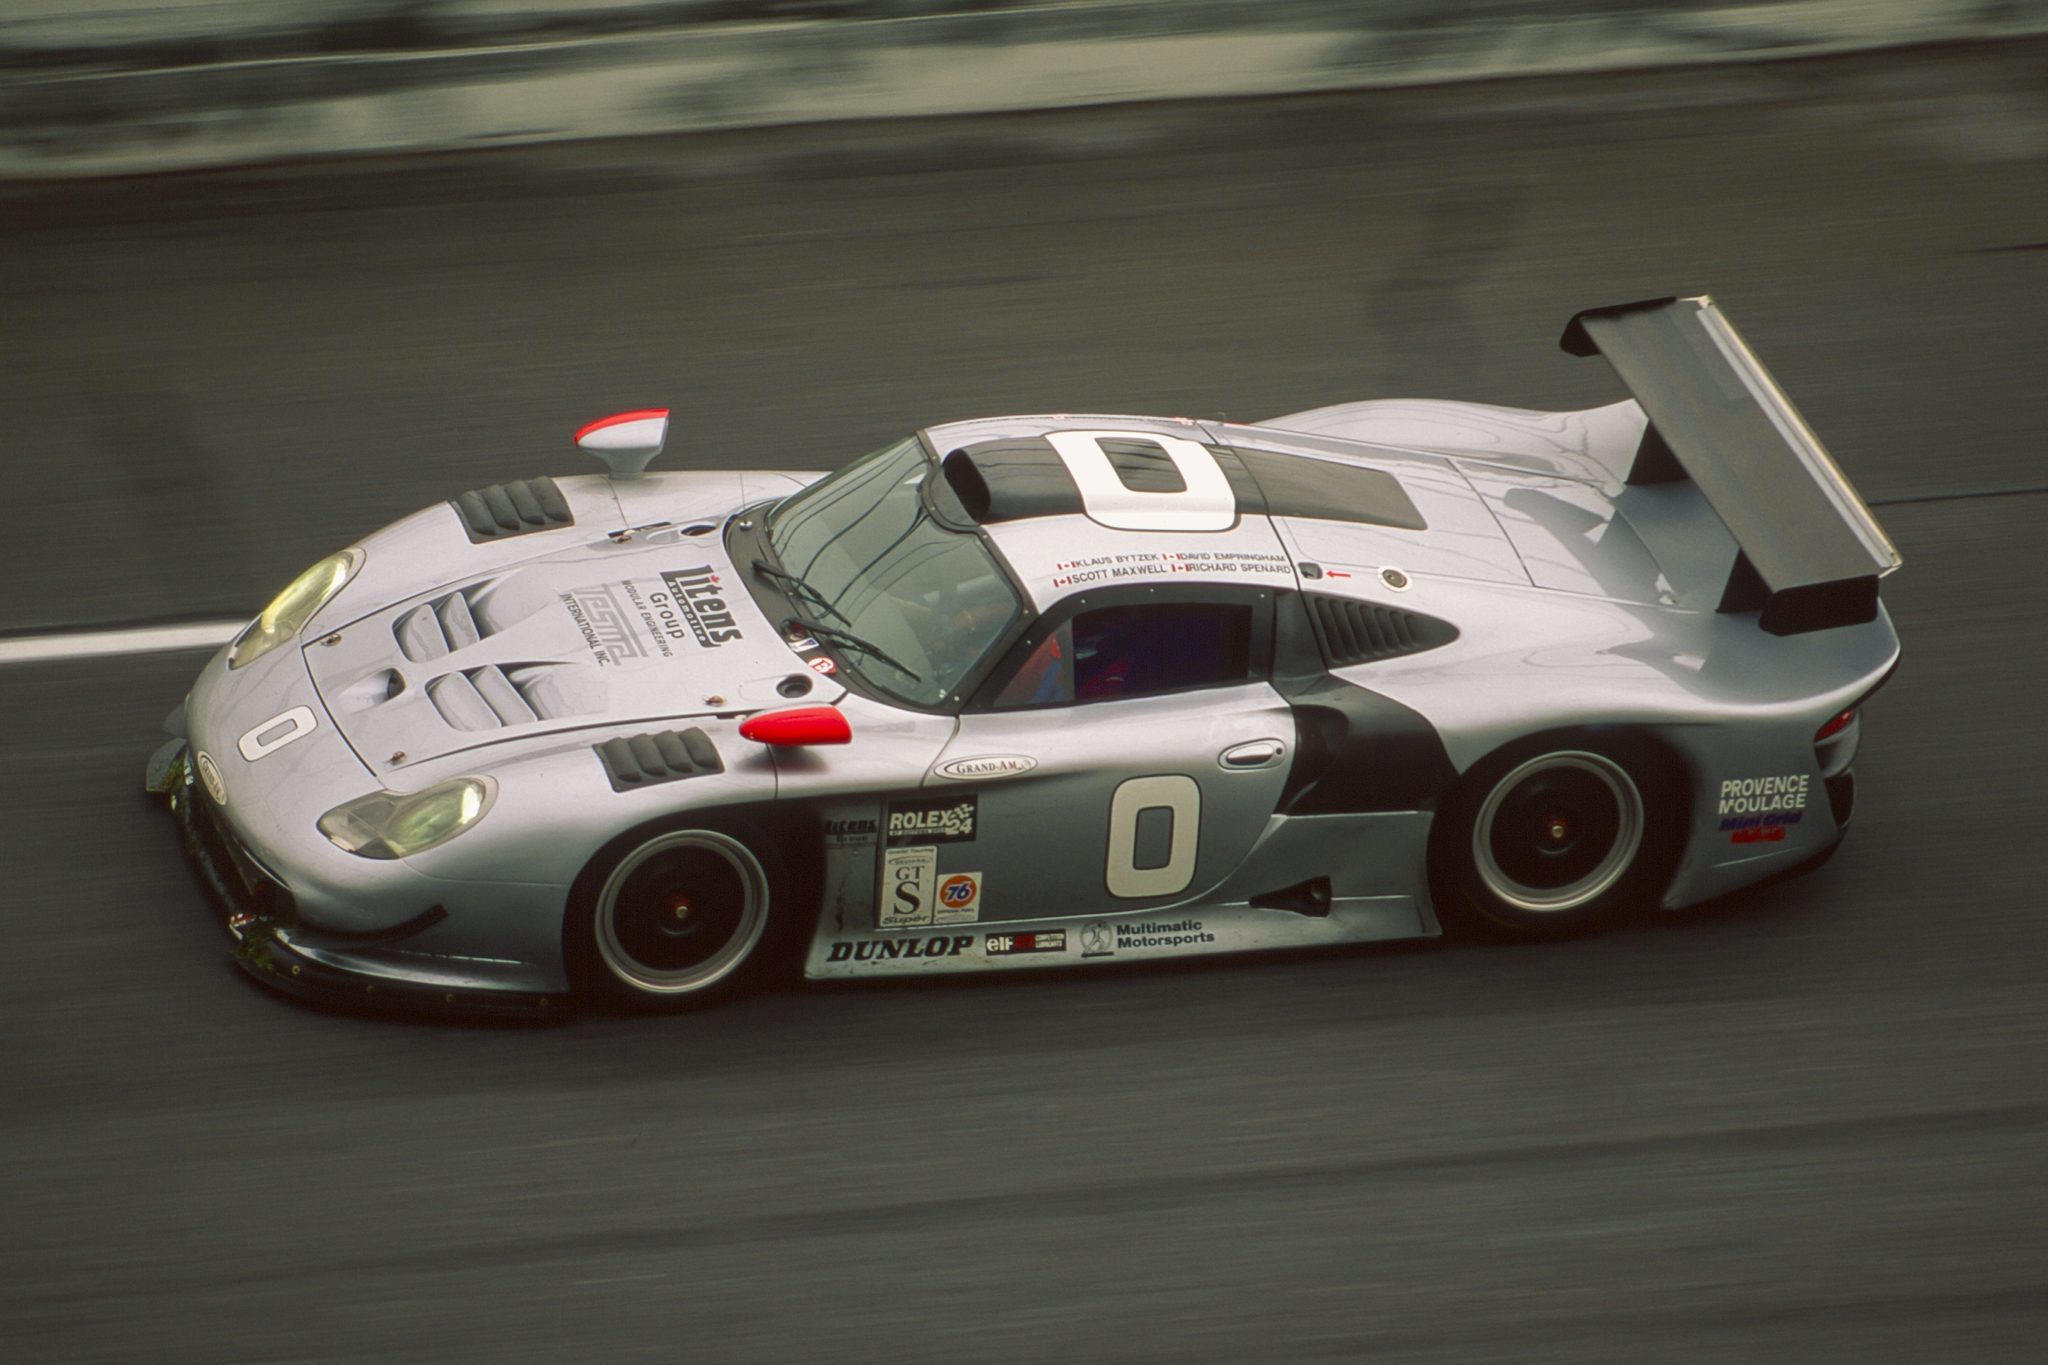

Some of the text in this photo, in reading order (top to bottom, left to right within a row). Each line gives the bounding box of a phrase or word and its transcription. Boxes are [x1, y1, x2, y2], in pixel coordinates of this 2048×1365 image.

[1076, 553, 1159, 568] KLAUS BYTZEK
[1180, 552, 1286, 562] DAVID EMPRINGHAM
[1190, 562, 1291, 574] RICHARD SPENARD
[1072, 564, 1167, 584] SCOTT MAXWELL
[559, 593, 602, 650] INTERNATIONAL
[621, 579, 674, 658] MODULAR ENGINEERING
[650, 592, 686, 640] Group
[667, 580, 707, 643] Automotive
[237, 705, 318, 762] 0
[1720, 775, 1810, 798] PROVENCE
[1718, 793, 1807, 815] MOULAGE
[889, 810, 952, 830] ROLEX
[946, 817, 973, 836] 24
[1104, 774, 1202, 899] 0
[895, 865, 926, 881] GT
[893, 880, 921, 916] S
[946, 883, 971, 902] 76
[1117, 919, 1203, 936] Multimatic
[826, 935, 975, 962] DUNLOP
[986, 936, 1014, 952] elf
[1117, 932, 1216, 949] Motorsports
